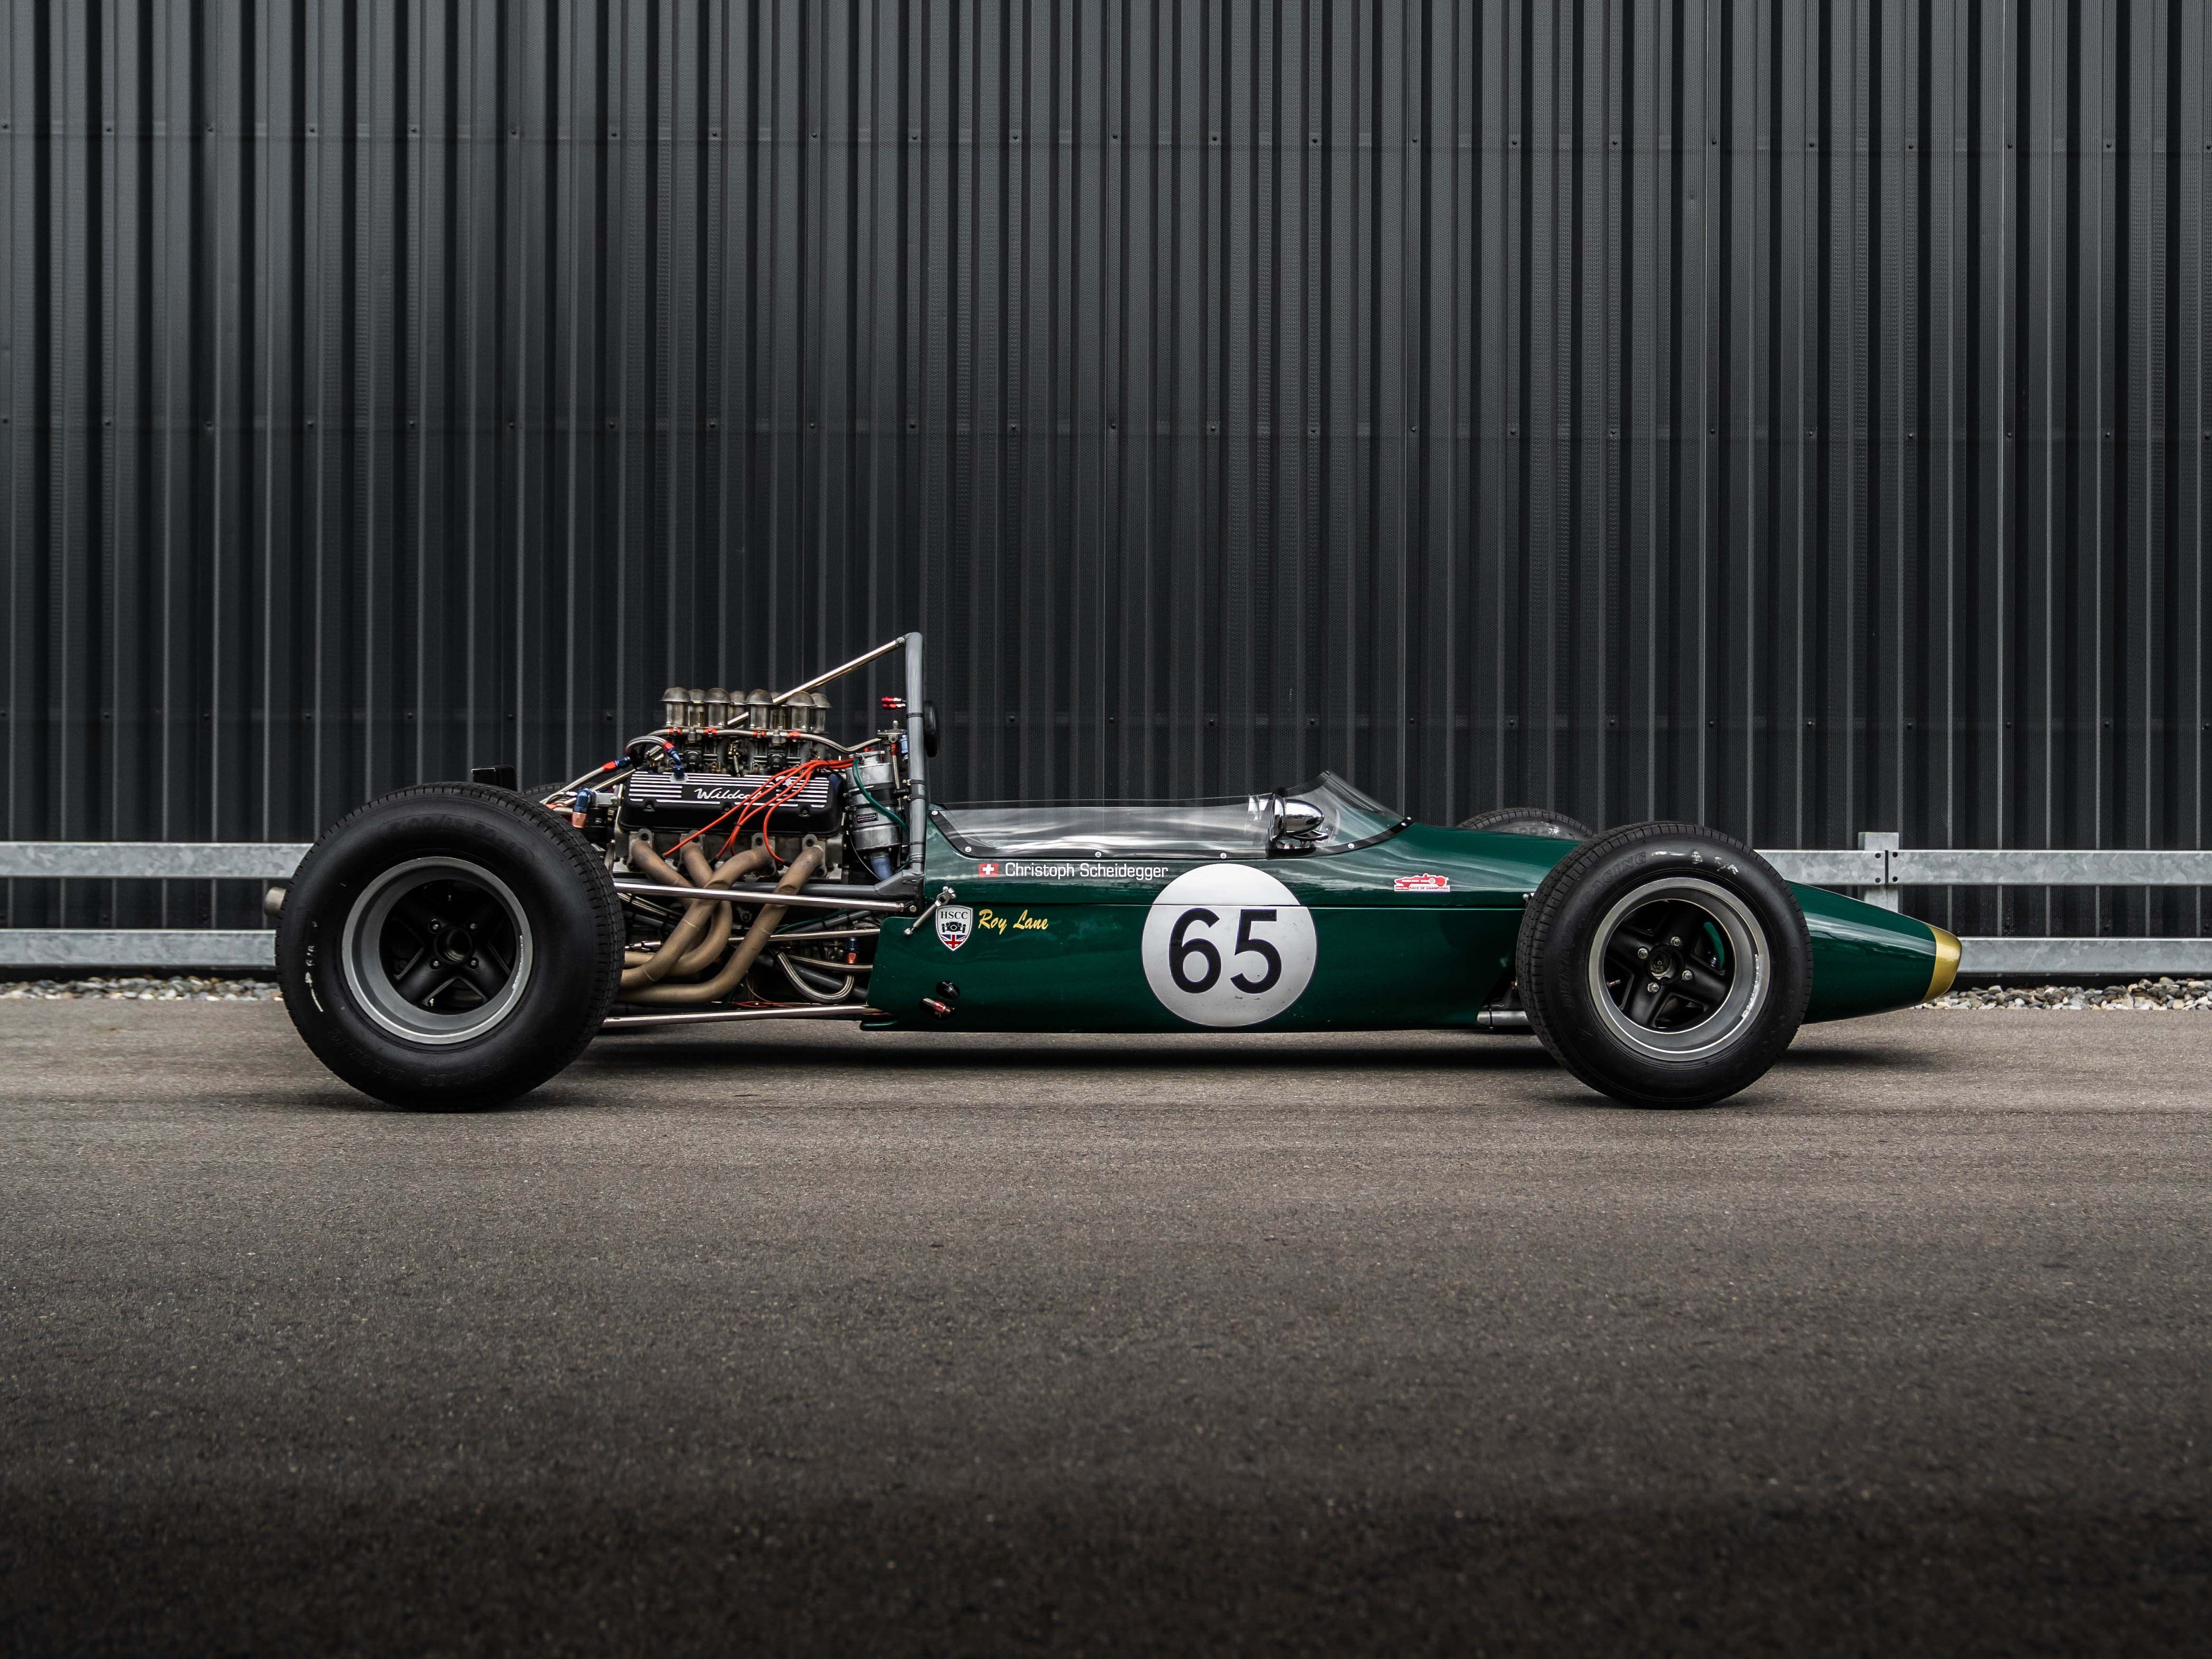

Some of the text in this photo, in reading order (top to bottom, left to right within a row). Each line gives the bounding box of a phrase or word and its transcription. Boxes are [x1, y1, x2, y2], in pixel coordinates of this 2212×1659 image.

[1005, 862, 1168, 880] Christoph Scheidegger
[1581, 851, 1646, 904] RACING
[941, 911, 968, 919] HSCC
[978, 909, 1049, 935] Roy Lane
[1169, 907, 1282, 994] 65
